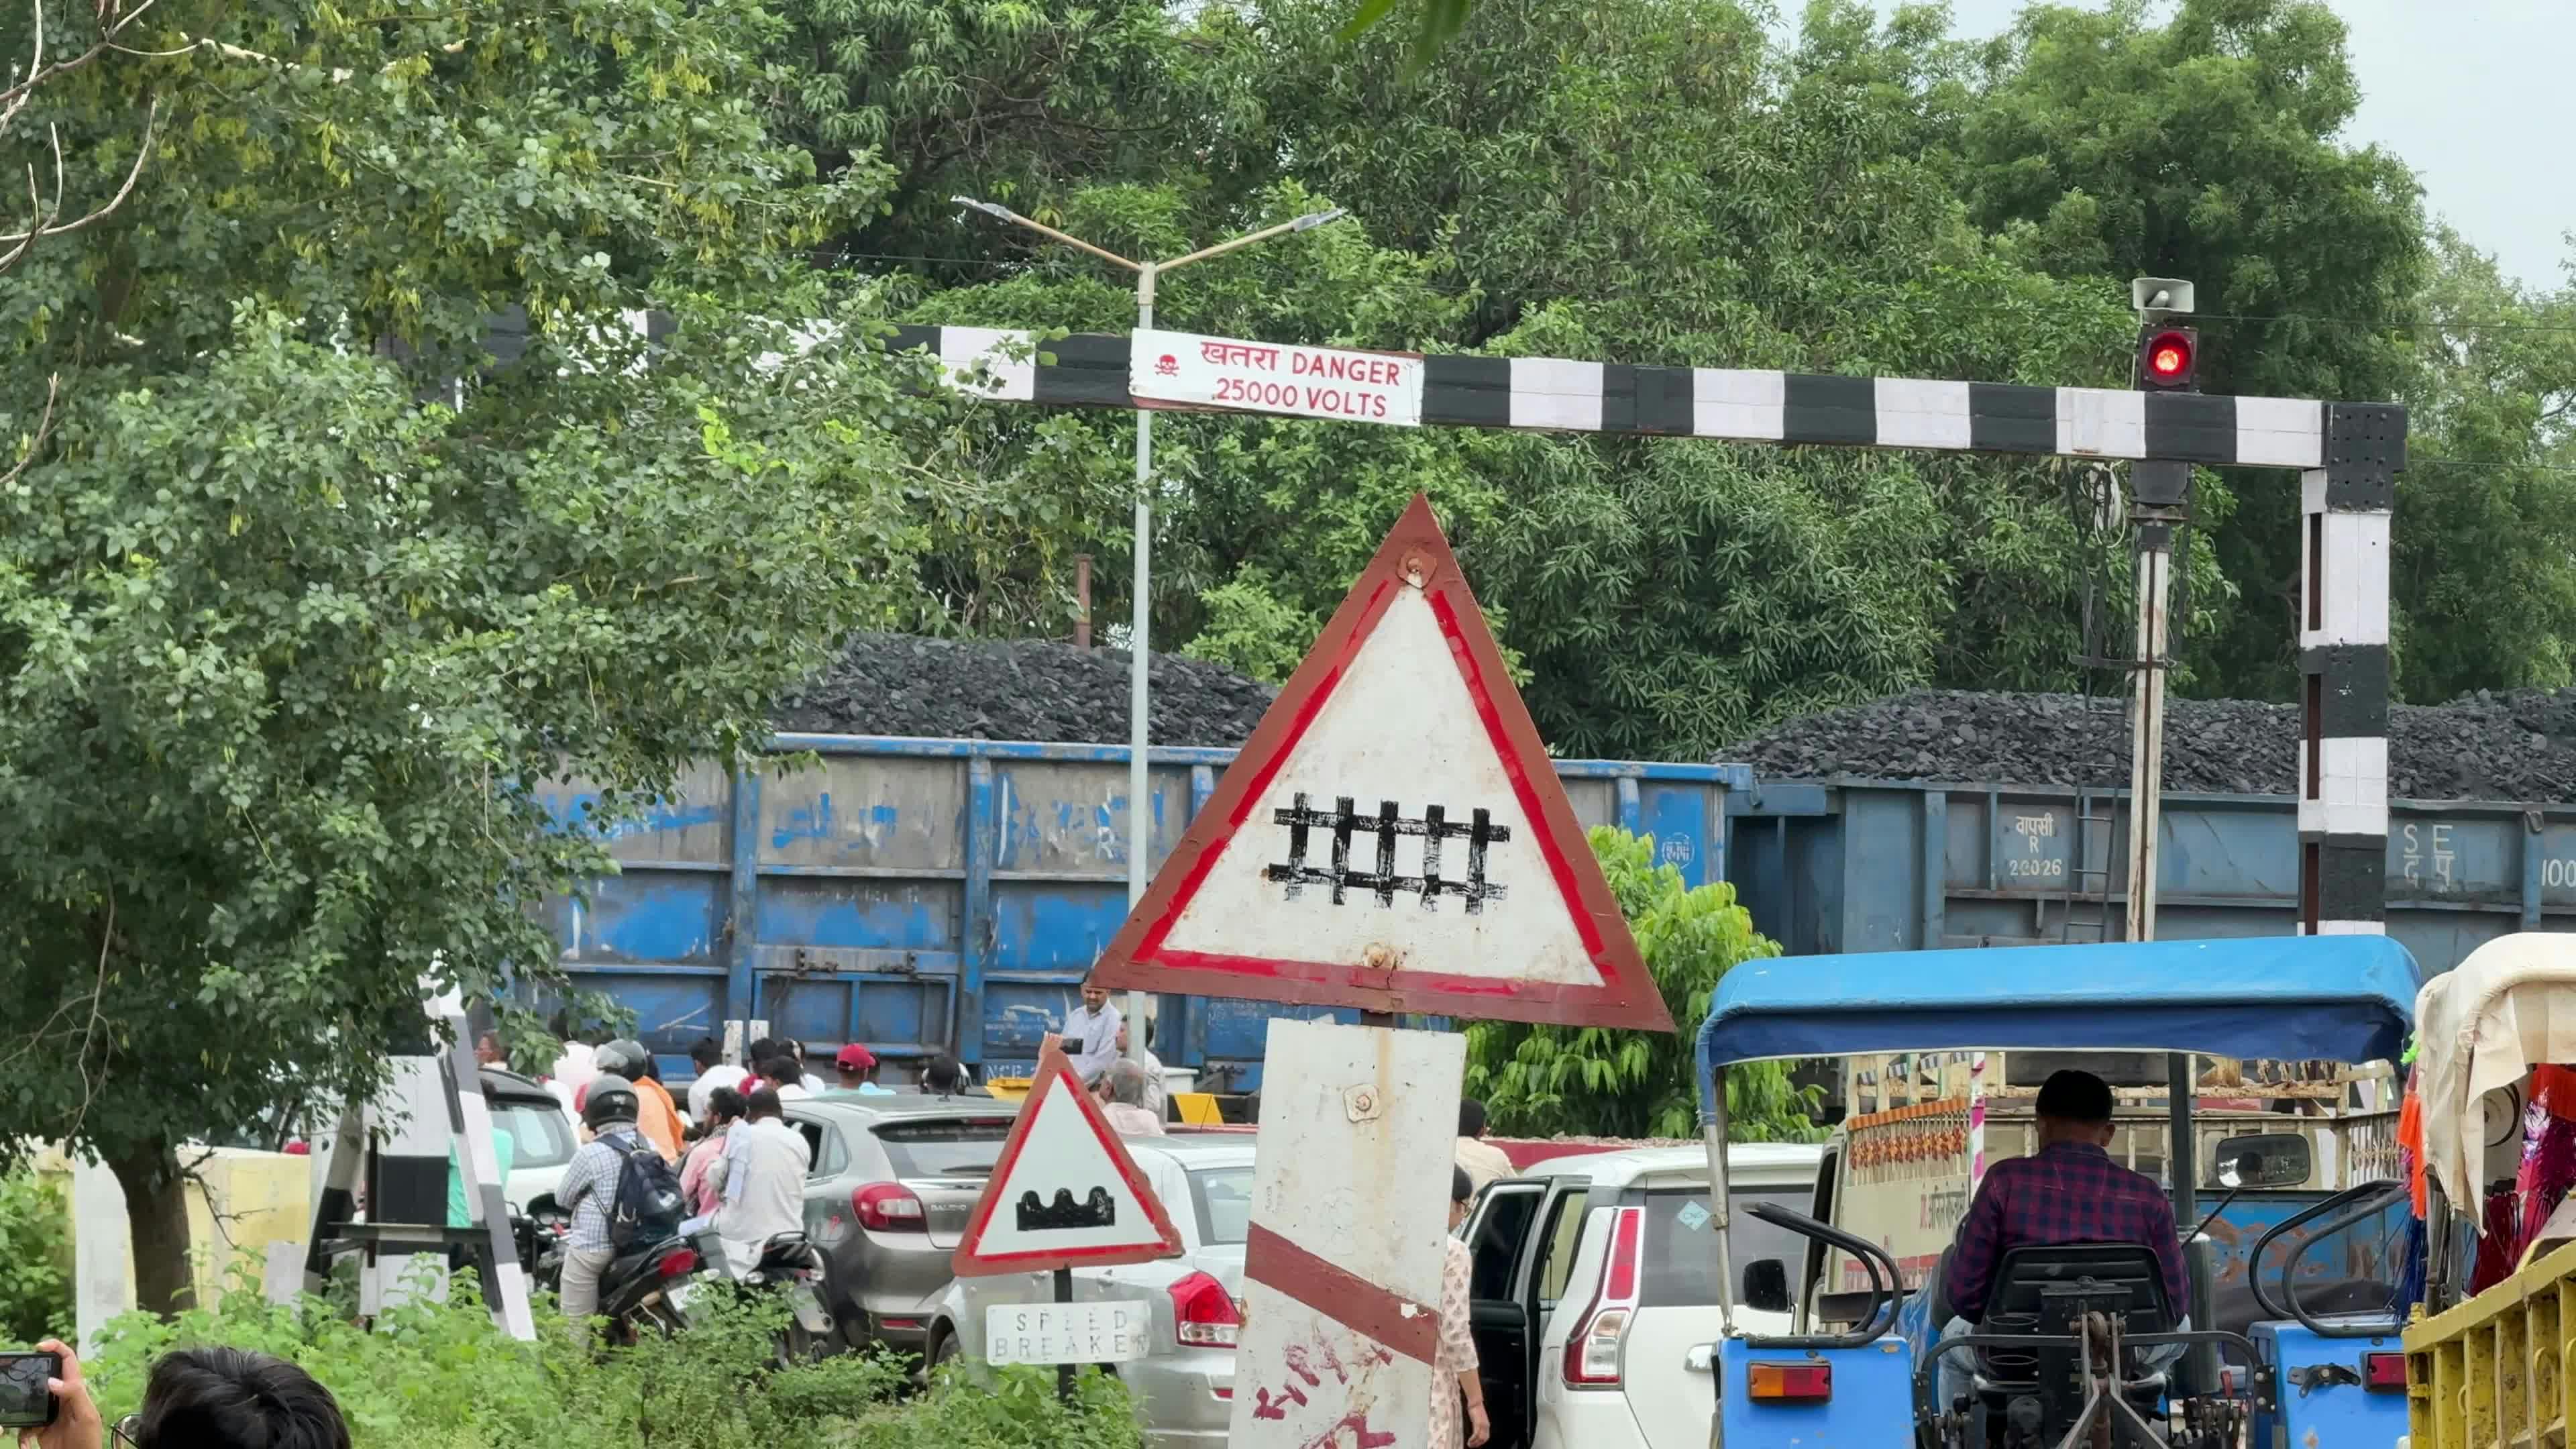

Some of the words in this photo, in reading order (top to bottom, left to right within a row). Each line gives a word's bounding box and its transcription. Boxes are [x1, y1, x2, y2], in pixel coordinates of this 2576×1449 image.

[1200, 341, 1280, 371] खतरा
[1292, 352, 1400, 386] DANGER
[1215, 378, 1298, 407] 25000
[1306, 388, 1387, 417] VOLTS
[2015, 812, 2054, 837] वापसी
[2029, 835, 2039, 853] R
